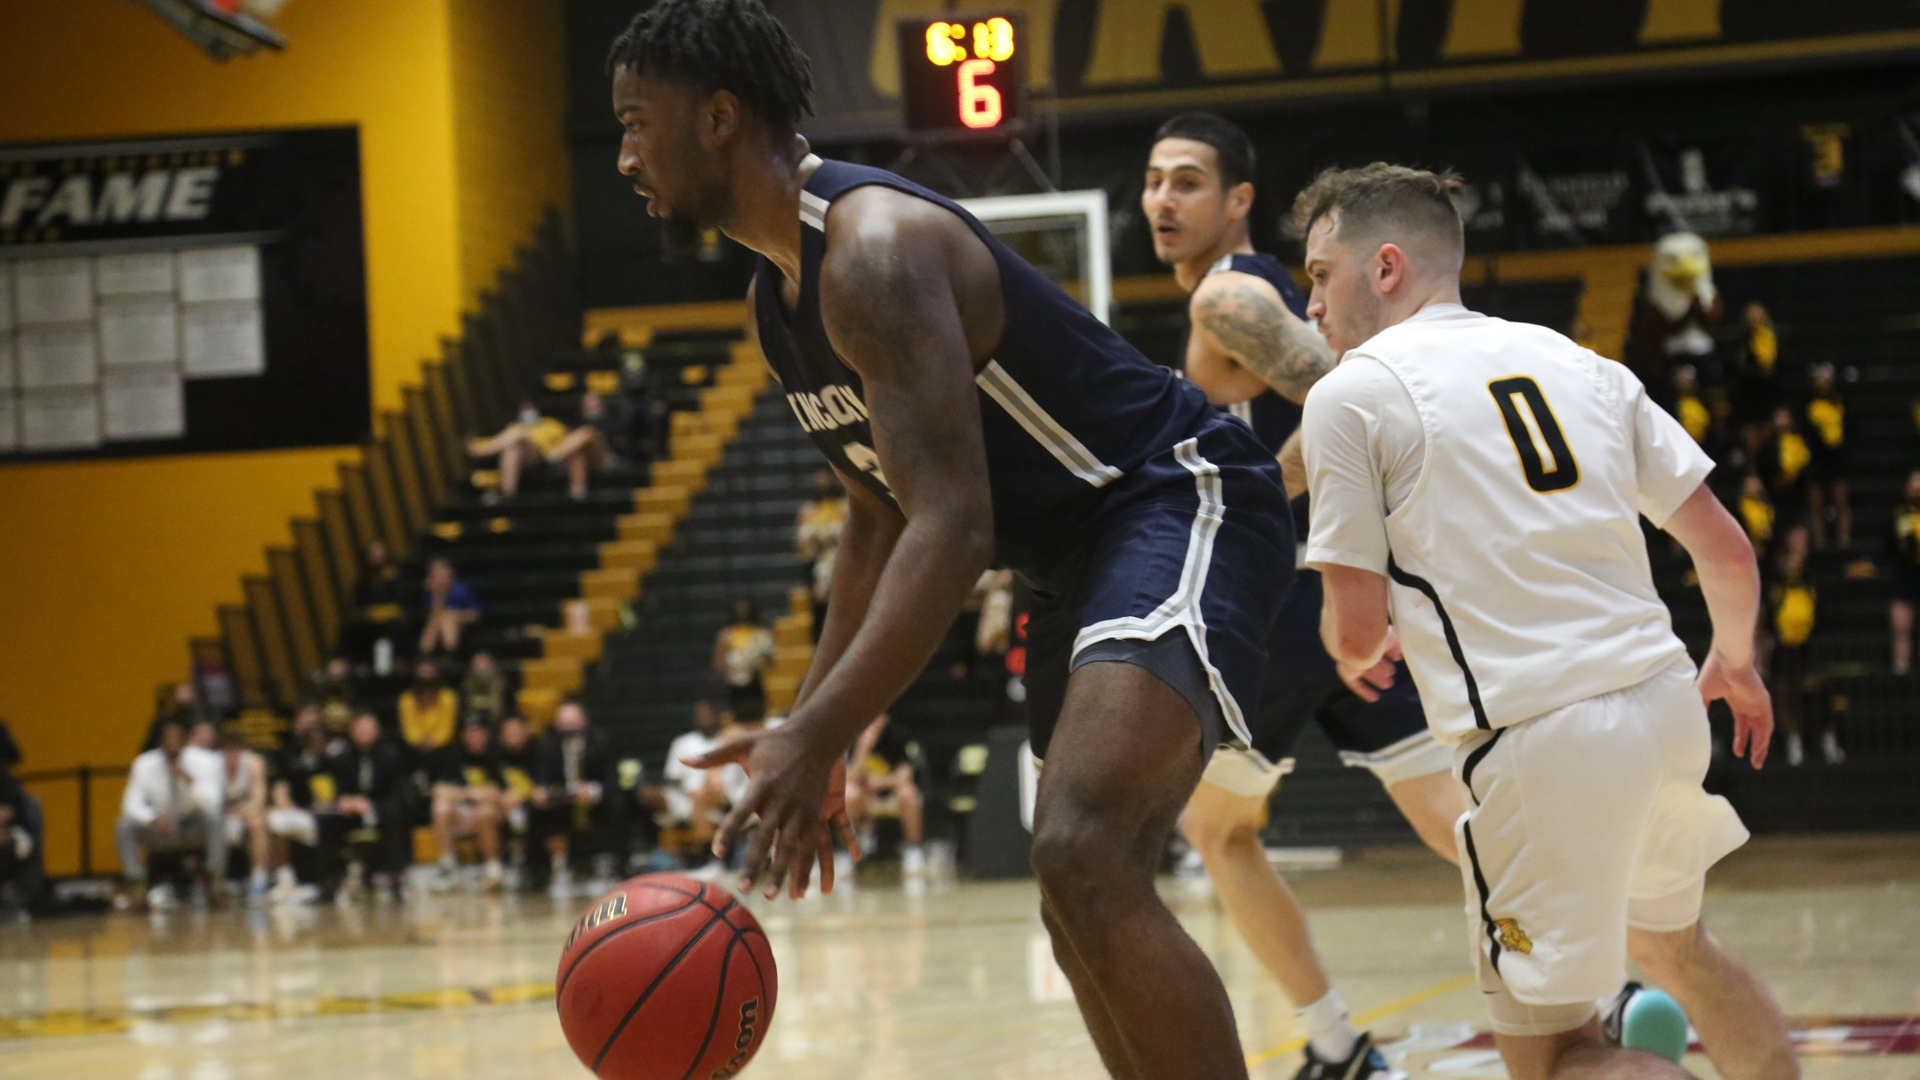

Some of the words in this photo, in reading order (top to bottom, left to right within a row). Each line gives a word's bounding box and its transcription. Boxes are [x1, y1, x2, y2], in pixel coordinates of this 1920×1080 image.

[957, 58, 1002, 129] 6
[0, 166, 220, 228] FAME
[1486, 373, 1581, 495] 0
